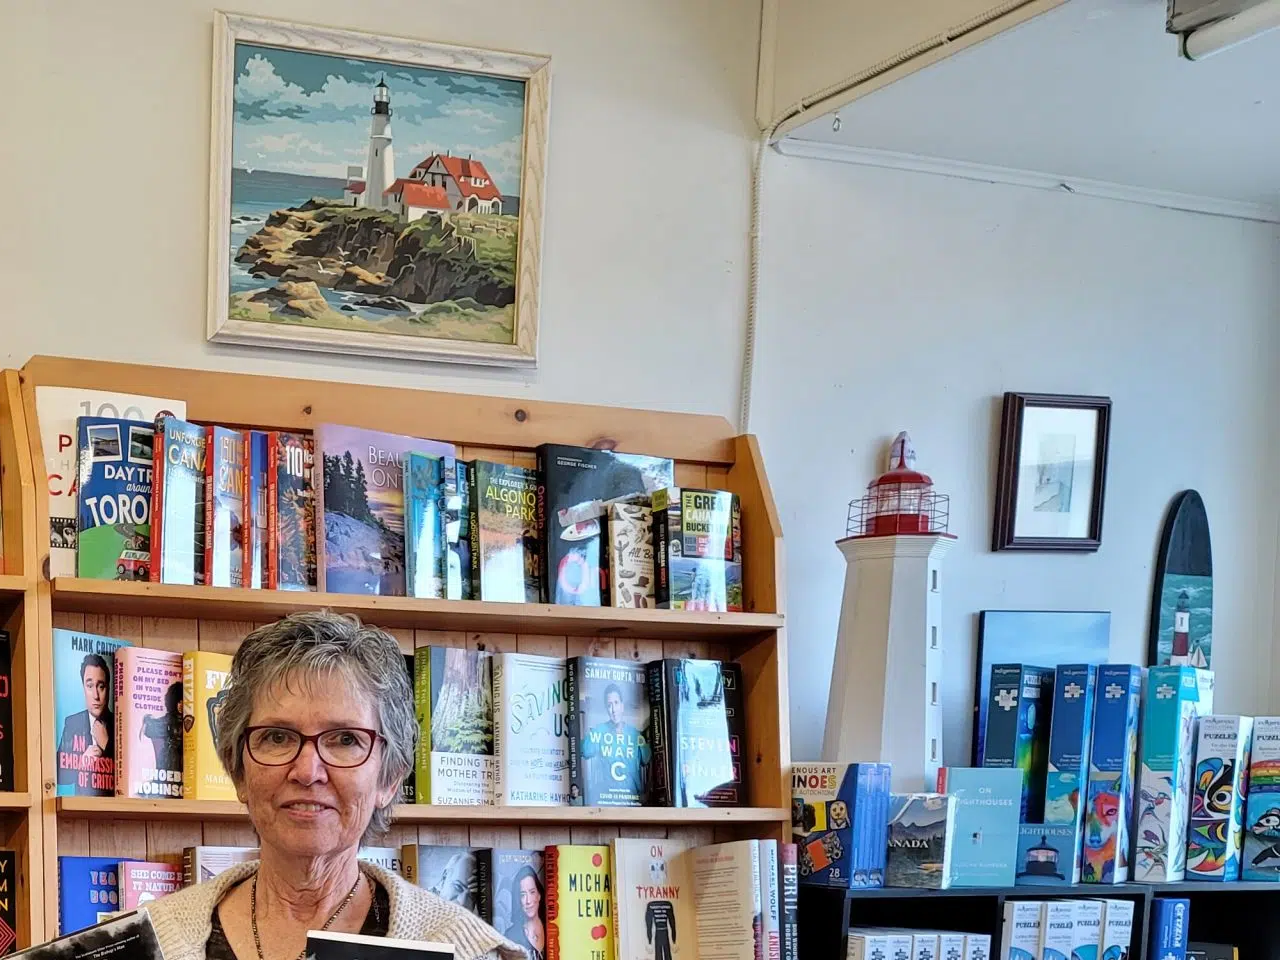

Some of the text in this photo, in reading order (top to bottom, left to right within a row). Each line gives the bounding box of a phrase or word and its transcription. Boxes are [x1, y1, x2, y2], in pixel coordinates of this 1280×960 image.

[557, 460, 576, 468] GEORGE
[104, 465, 136, 481] DAY
[71, 636, 93, 651] MARK
[137, 667, 163, 676] PLEASE
[132, 694, 161, 702] OUTSIDE
[134, 703, 164, 712] CLOTHES
[589, 732, 646, 747] WORLD
[601, 746, 634, 759] WAR
[440, 756, 481, 768] FINDING
[438, 768, 478, 779] MOTHER
[611, 762, 627, 782] C
[650, 845, 663, 859] ON
[829, 868, 840, 878] 28
[635, 886, 681, 899] TYRANNY
[783, 863, 797, 914] PERIL
